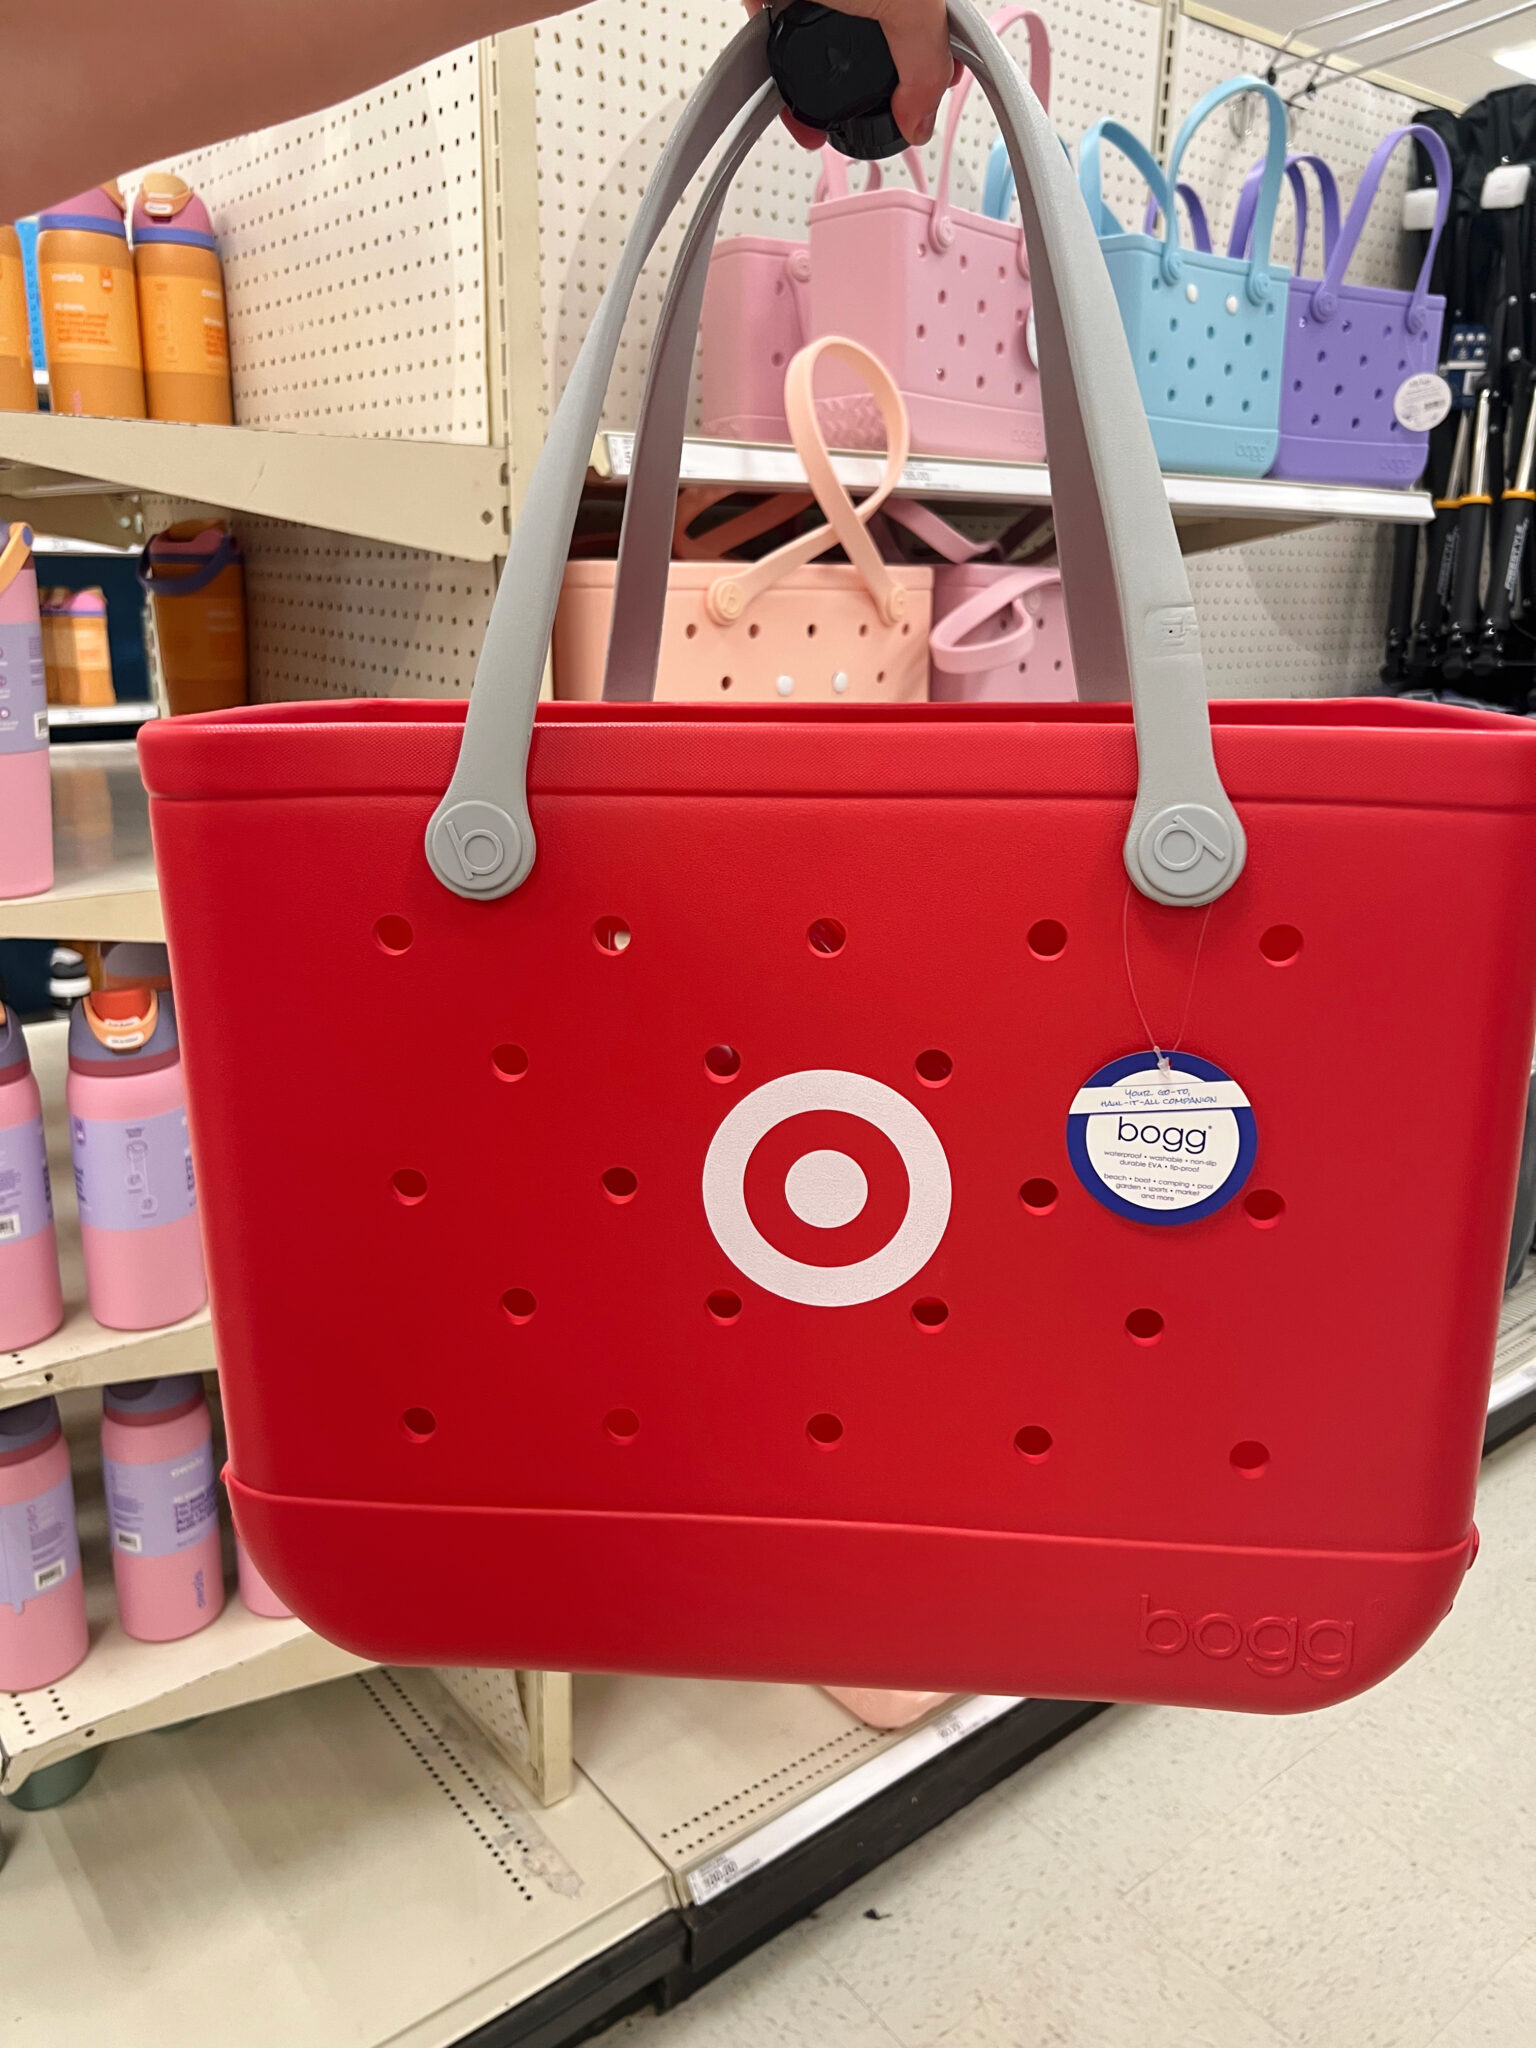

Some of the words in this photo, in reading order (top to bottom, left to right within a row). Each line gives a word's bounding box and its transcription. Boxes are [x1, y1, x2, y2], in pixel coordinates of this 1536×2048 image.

[445, 820, 504, 881] b
[1162, 1096, 1218, 1105] COMPANION
[1118, 1116, 1207, 1155] bogg
[1104, 1150, 1142, 1160] waterproof
[1149, 1154, 1183, 1163] washable
[1190, 1158, 1217, 1167] non-slip
[1119, 1159, 1146, 1168] durable
[1147, 1161, 1163, 1169] EVA
[1169, 1164, 1200, 1173] tip-proof
[1103, 1173, 1127, 1181] beach
[1134, 1175, 1151, 1184] boat
[1158, 1179, 1190, 1189] camping
[1197, 1182, 1214, 1190] pool
[1115, 1182, 1142, 1191] garden
[1148, 1186, 1168, 1194] sports
[1174, 1188, 1200, 1196] market
[1140, 1192, 1156, 1200] and
[1156, 1193, 1175, 1202] more
[1137, 1593, 1356, 1682] bogg
